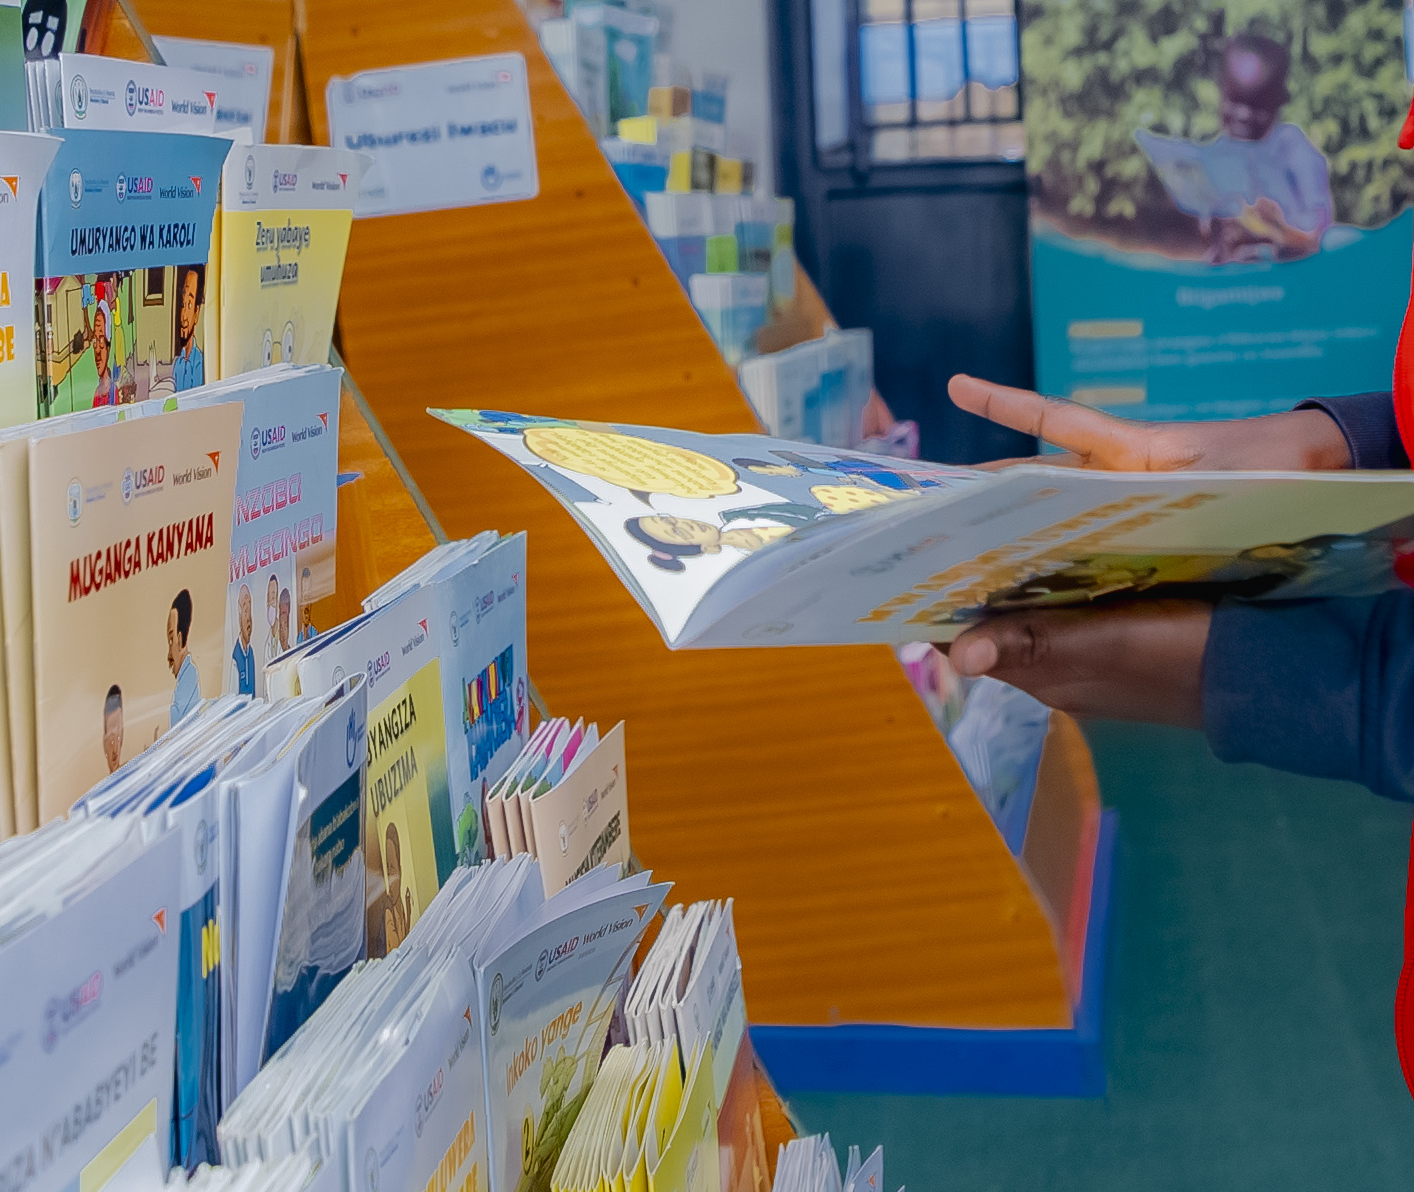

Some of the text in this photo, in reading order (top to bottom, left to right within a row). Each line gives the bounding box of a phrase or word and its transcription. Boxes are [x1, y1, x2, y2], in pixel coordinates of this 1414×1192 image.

[138, 87, 164, 106] USAID
[171, 99, 207, 114] World Vision
[127, 177, 153, 193] USAID
[159, 186, 194, 198] World Vision
[70, 222, 197, 256] UMURYANGO WA KAROLI
[261, 424, 286, 446] USAID
[291, 424, 323, 443] World Vision
[135, 465, 165, 489] USAID
[173, 466, 212, 486] World Vision
[67, 512, 215, 603] MUGANGA KANYANA
[374, 651, 390, 675] USAID
[370, 746, 418, 818] UBUZIMA
[583, 918, 633, 945] World Vision
[548, 936, 579, 964] USAID
[506, 1001, 582, 1096] Inkoko yange
